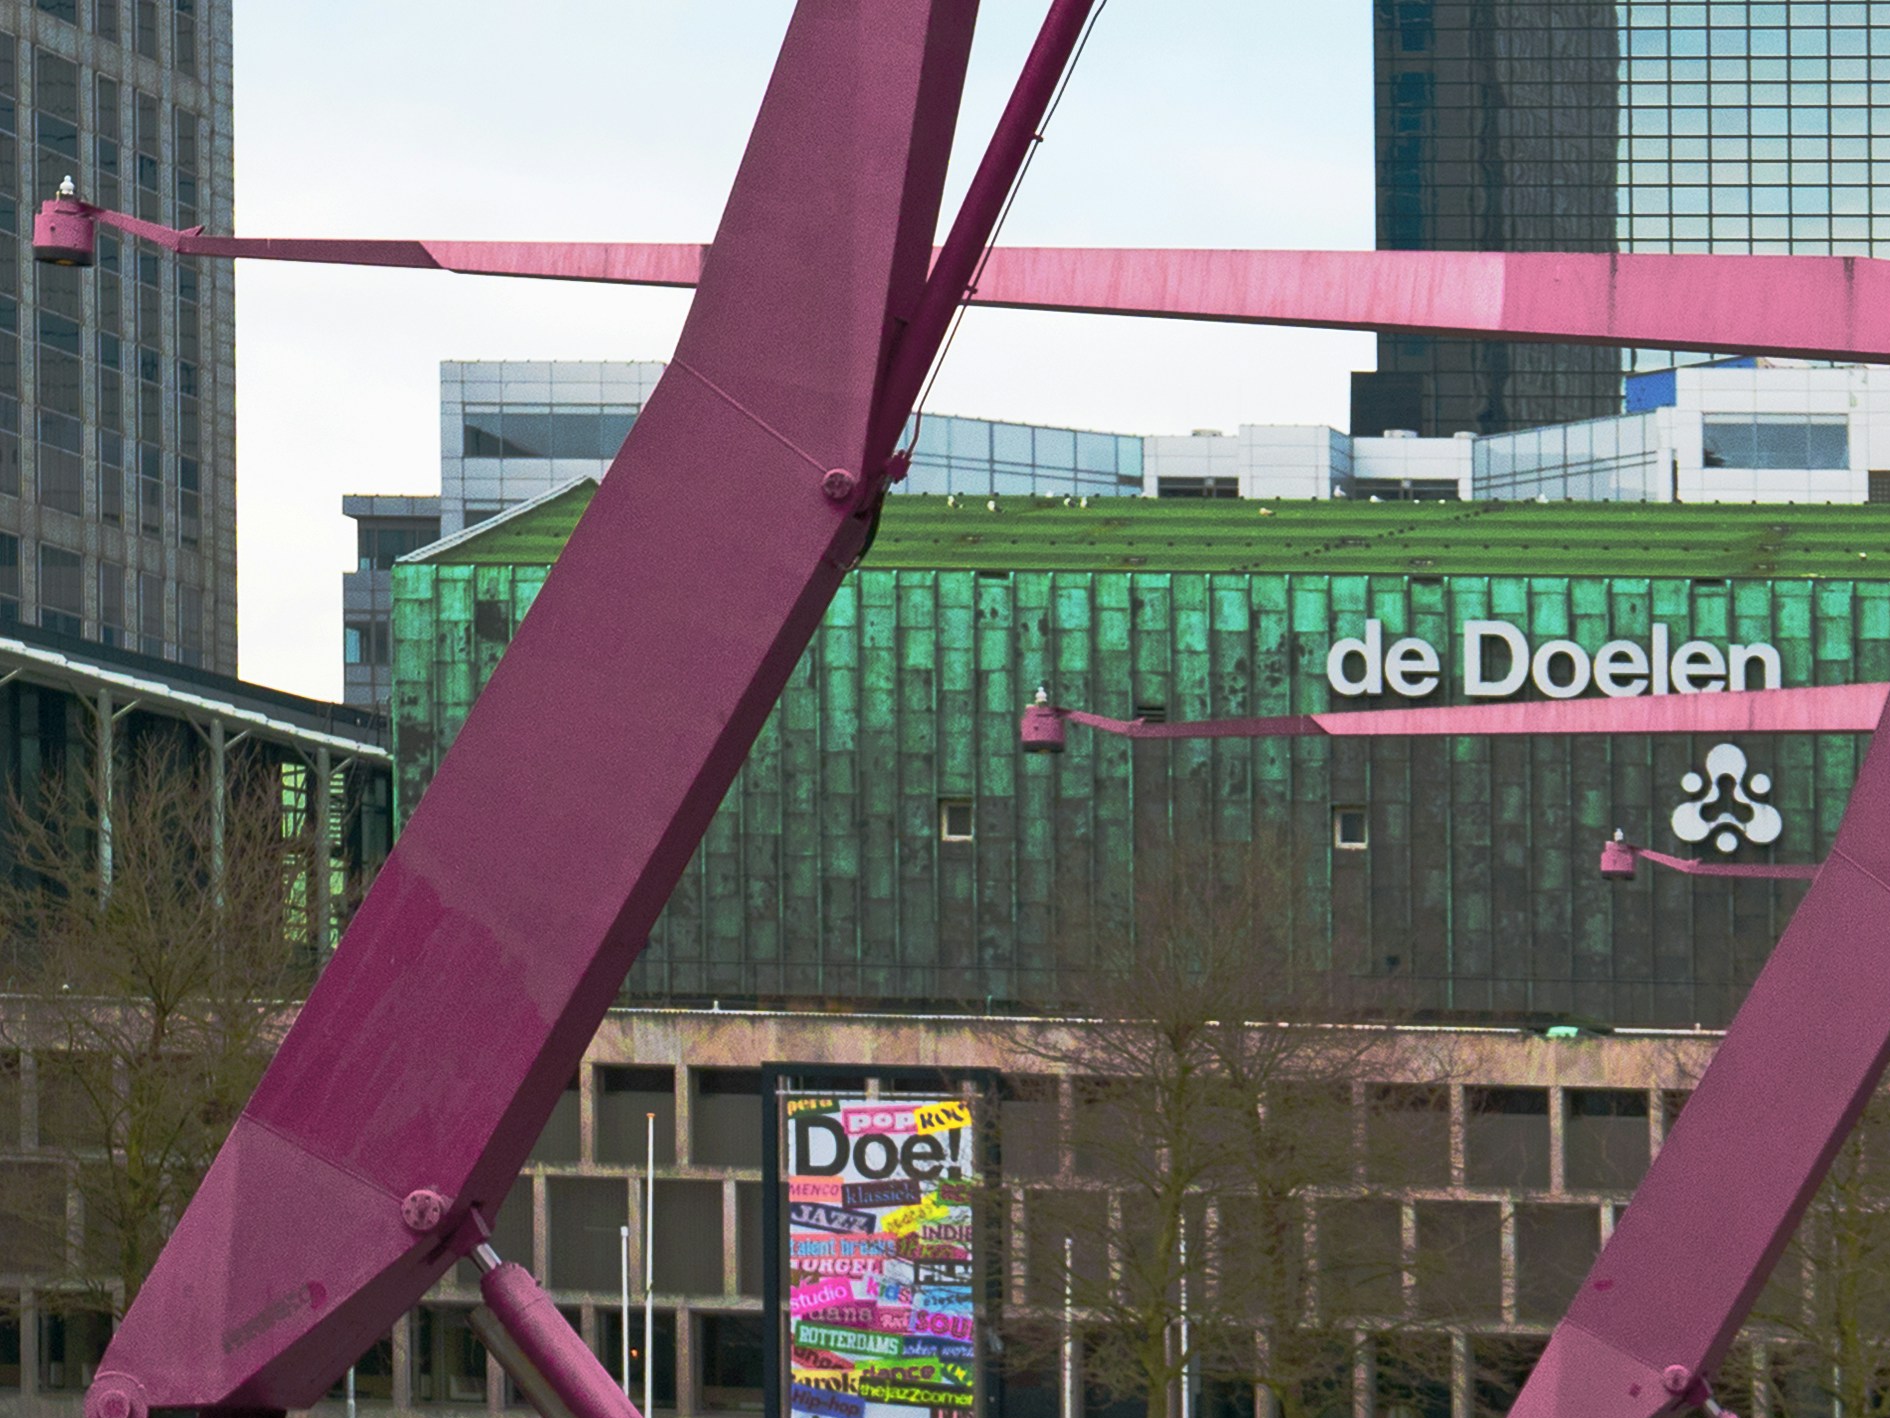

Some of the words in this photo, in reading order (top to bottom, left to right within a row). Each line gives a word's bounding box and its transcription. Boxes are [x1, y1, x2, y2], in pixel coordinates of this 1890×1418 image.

[1326, 618, 1441, 699] de
[1463, 619, 1782, 699] Doelen
[796, 1115, 962, 1180] Doe!
